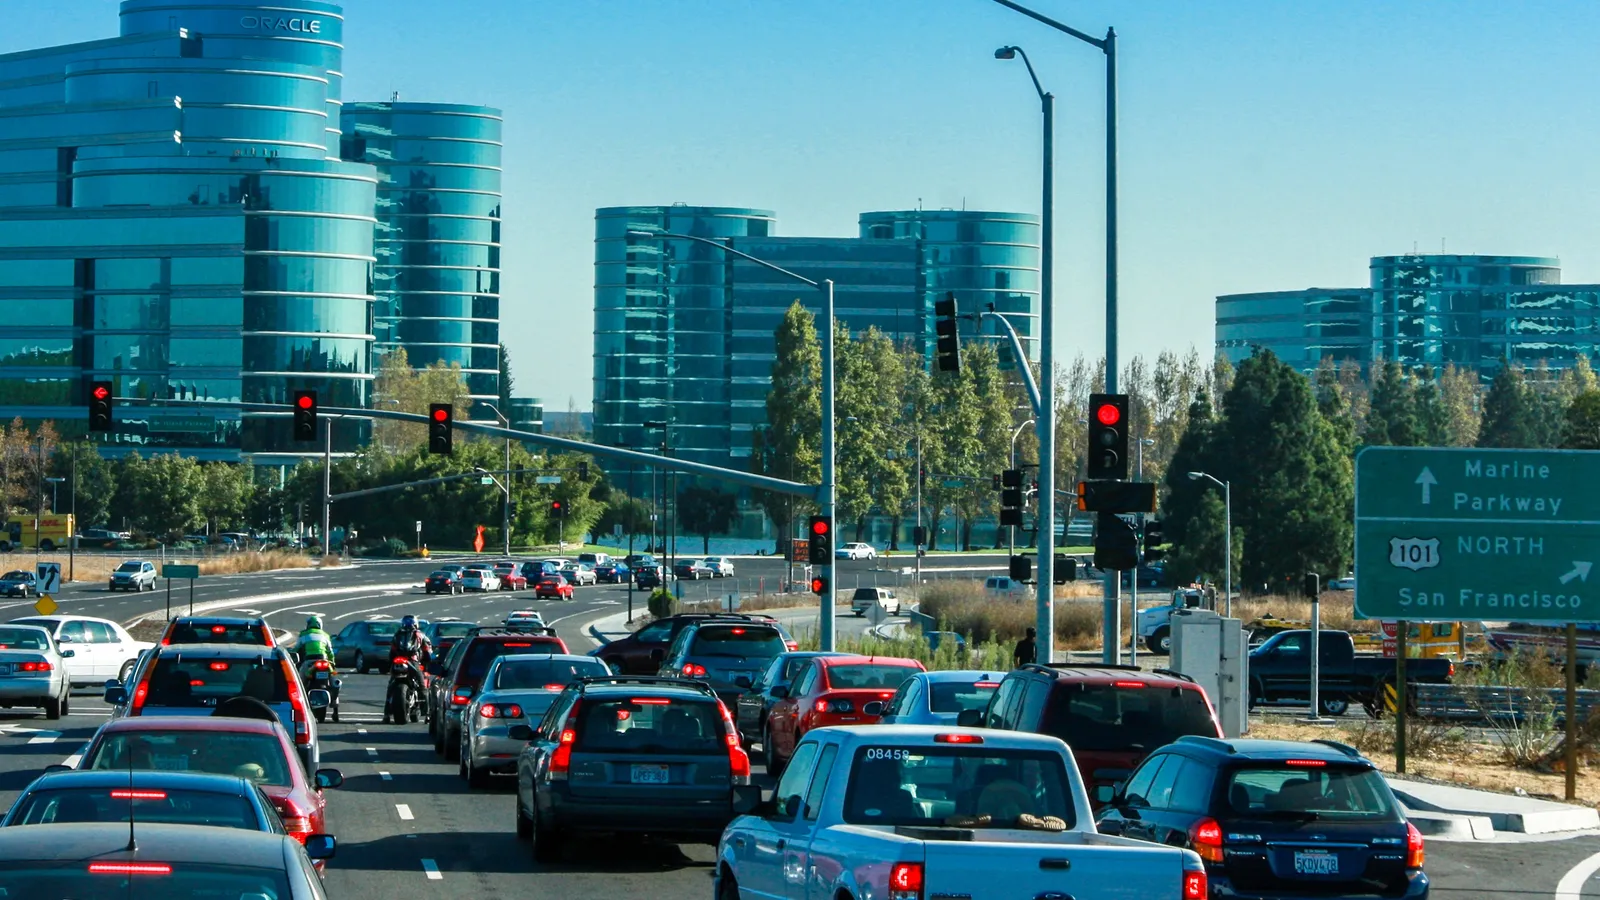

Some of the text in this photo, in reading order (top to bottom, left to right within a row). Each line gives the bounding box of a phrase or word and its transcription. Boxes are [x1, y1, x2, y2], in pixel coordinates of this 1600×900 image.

[240, 15, 321, 34] ORACLE
[1465, 459, 1551, 479] Marine
[1453, 492, 1563, 516] Parkway
[1400, 544, 1431, 563] 101
[1457, 535, 1544, 556] NORTH
[1398, 587, 1582, 609] San Francisco
[867, 748, 910, 761] 08458
[1296, 857, 1337, 872] 5KDV478
